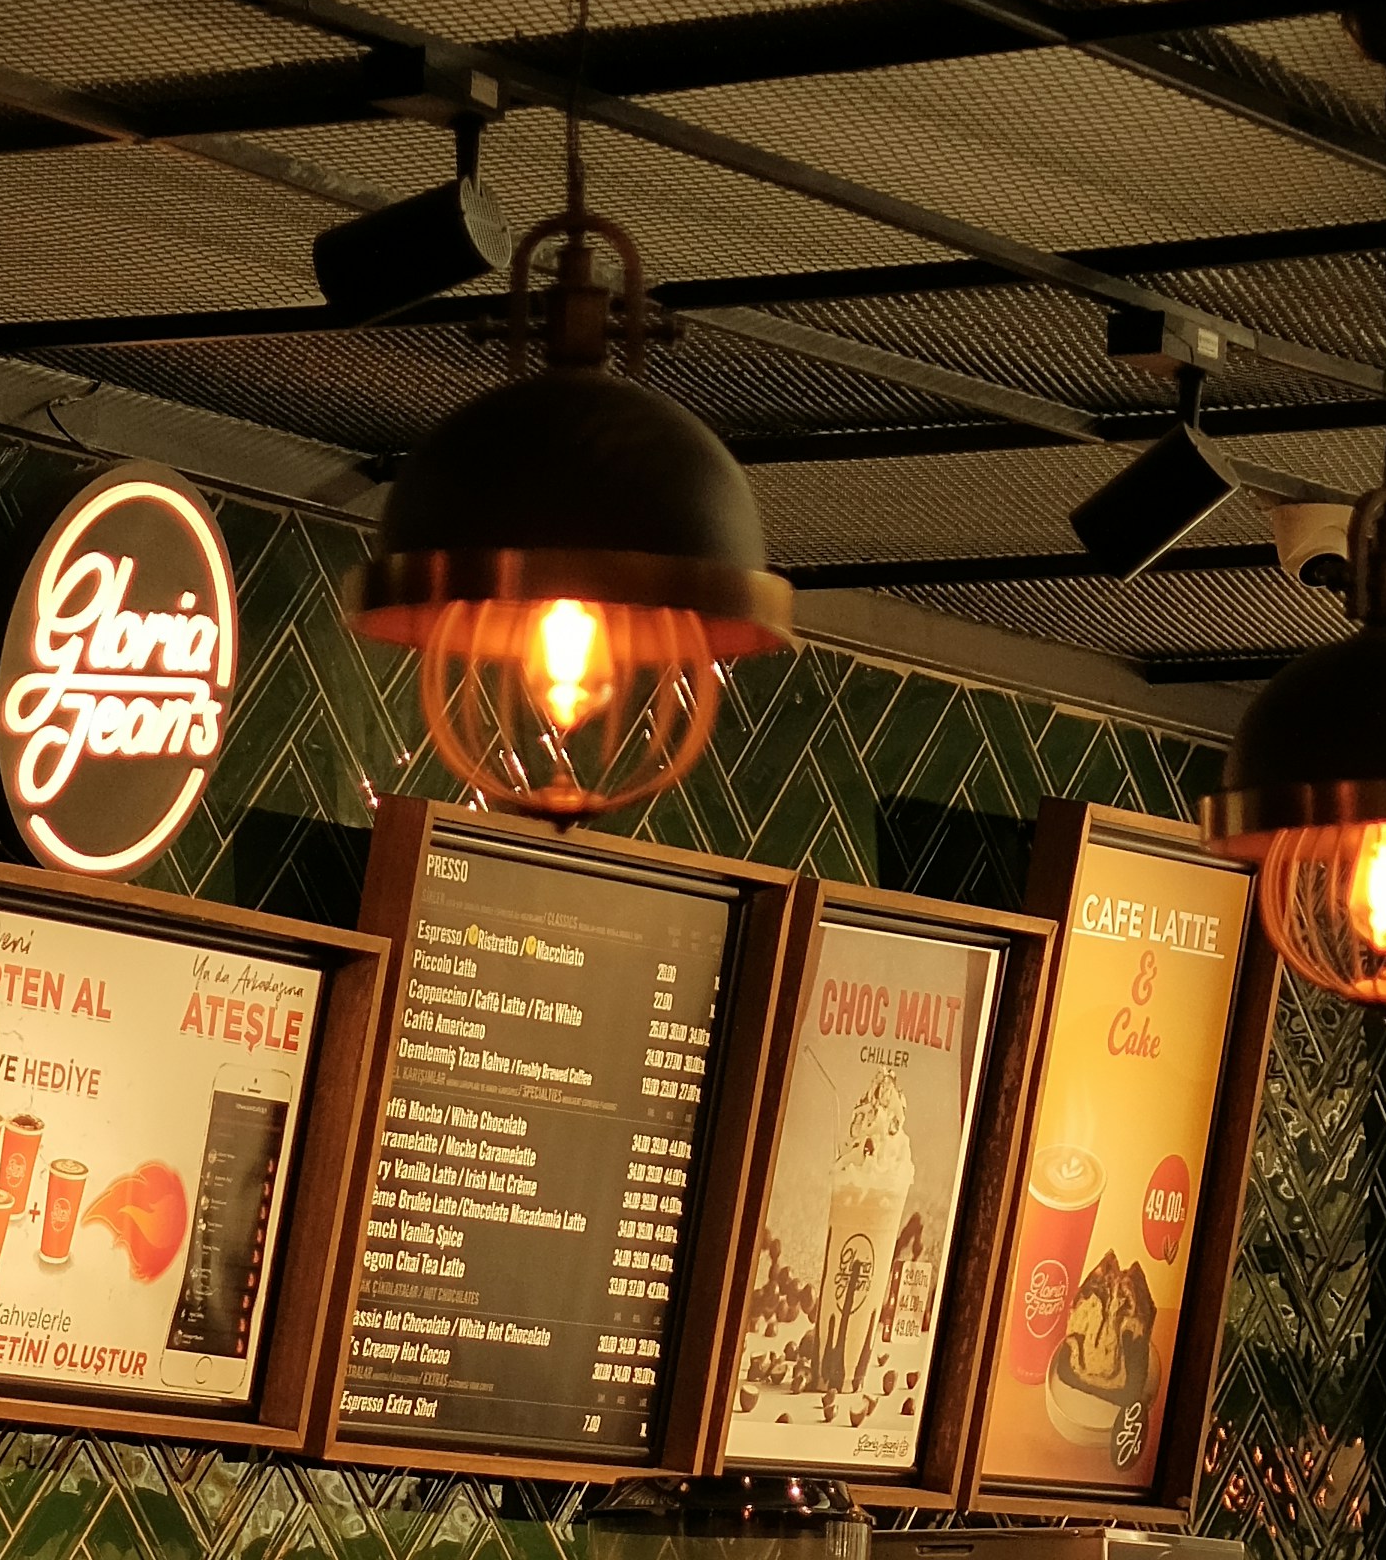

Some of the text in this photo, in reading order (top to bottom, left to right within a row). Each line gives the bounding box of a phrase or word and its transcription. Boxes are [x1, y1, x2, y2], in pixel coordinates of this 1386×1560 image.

[4, 551, 219, 733] Gloria
[18, 692, 223, 805] Jean's
[426, 854, 468, 882] PRESSO
[1082, 893, 1220, 952] CAFE LATTE
[417, 919, 585, 967] Espresso Ristretto Macchiato
[413, 949, 477, 978] Piccolo Latte
[1131, 949, 1158, 1006] &
[72, 978, 111, 1019] AL
[408, 979, 583, 1026] Cappuccino Latte White
[819, 979, 961, 1052] CHOC MALT
[180, 992, 304, 1052] ATEŞLE
[435, 1016, 486, 1040] Americano
[1107, 1007, 1161, 1059] Cake
[860, 1045, 909, 1067] CHILLER
[22, 1058, 101, 1096] HEDİYE
[409, 1101, 527, 1136] Mocha Chocolate
[394, 1159, 457, 1186] Vanilla Latte
[401, 1219, 464, 1250] Vanilla Spice
[510, 1203, 587, 1232] Macadamia Latte
[440, 1255, 465, 1278] Latte
[402, 1312, 551, 1347] Chocolate White Chocolate
[53, 1342, 147, 1376] OLUŞTUR
[363, 1338, 450, 1365] Creamy Cocoa
[340, 1391, 412, 1415] Espresso Extra
